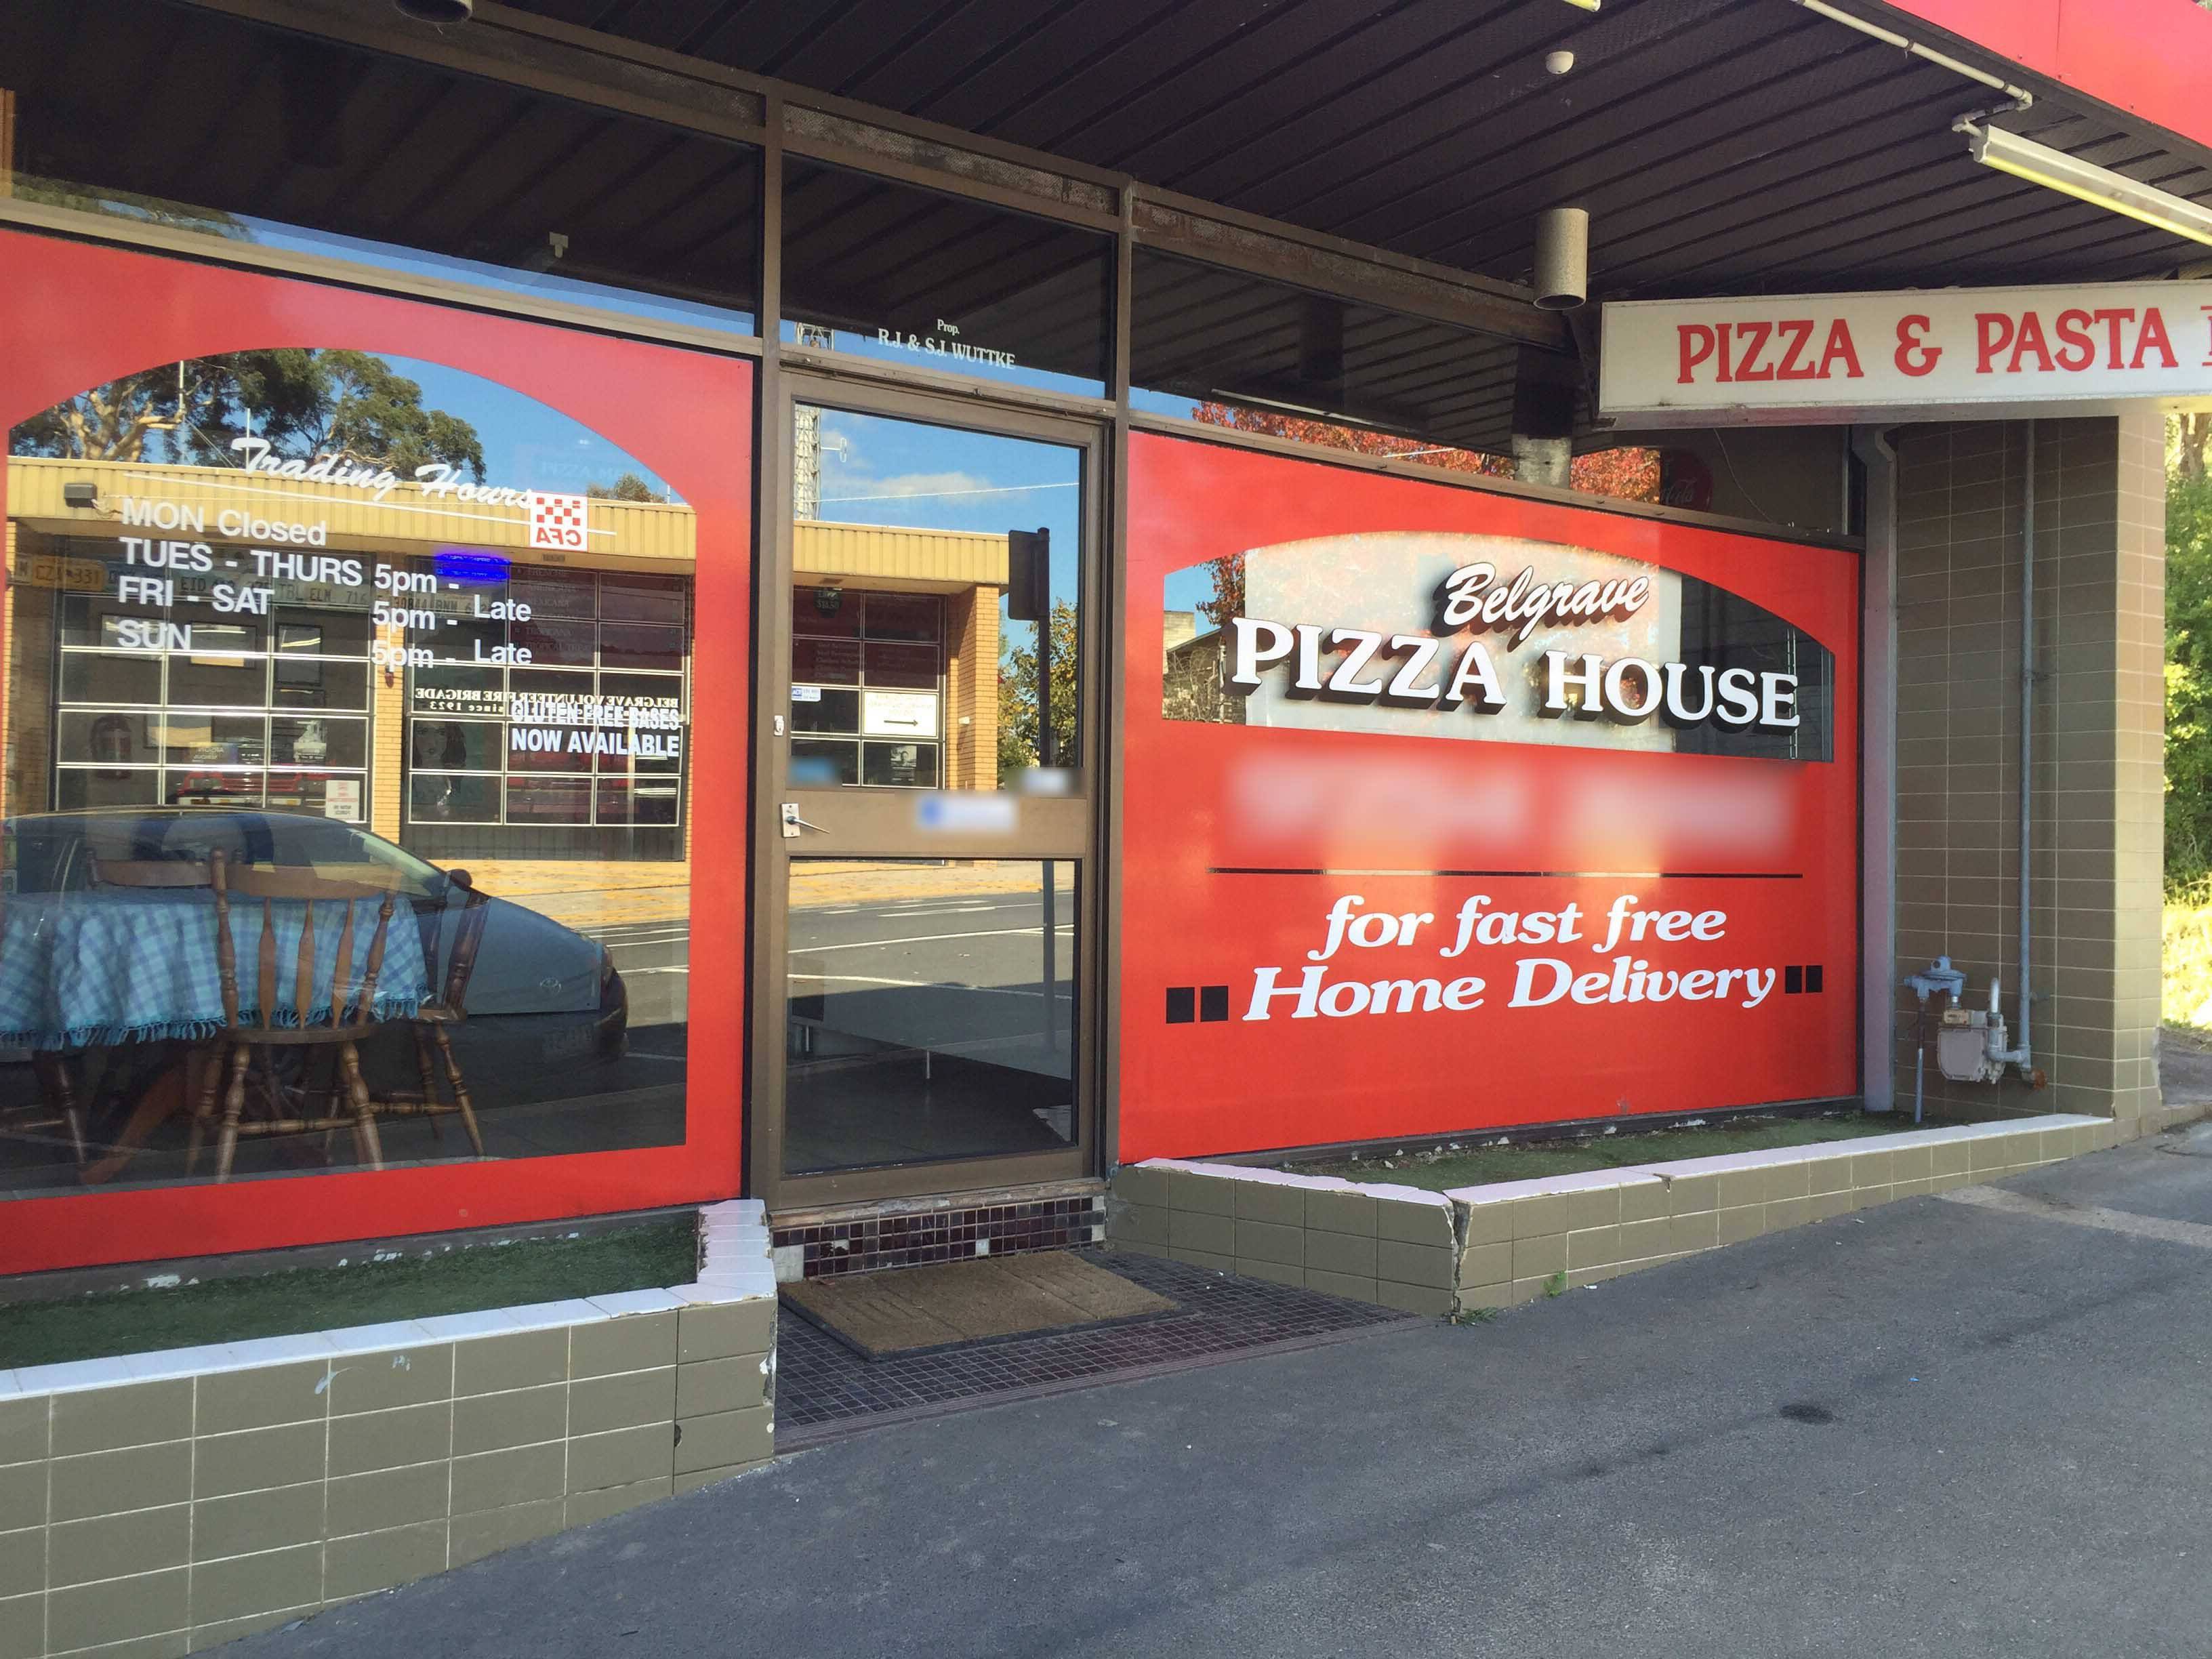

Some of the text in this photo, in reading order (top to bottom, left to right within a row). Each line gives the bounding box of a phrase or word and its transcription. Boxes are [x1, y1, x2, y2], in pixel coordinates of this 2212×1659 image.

[878, 328, 1016, 369] R.J. & S.J. WUTTKE
[937, 319, 960, 335] Prop.
[1677, 319, 1864, 384] PIZZA
[1894, 314, 1942, 377] &
[1974, 307, 2178, 373] PASTA
[230, 437, 532, 510] Trading Hours
[121, 498, 326, 546] MON Closed
[119, 537, 213, 572] TUES
[250, 550, 363, 586] THURS
[373, 564, 437, 596] 5pm
[118, 576, 173, 607] FRI
[212, 584, 274, 615] SAT
[372, 600, 436, 630] 5pm
[474, 594, 532, 621] Late
[1441, 561, 1650, 642] Belgrave
[117, 619, 191, 650] SUN
[371, 640, 434, 672] 5pm
[474, 639, 532, 665] Late
[1229, 617, 1801, 729] PIZZA HOUSE
[511, 700, 578, 724] GLUTEN
[583, 704, 624, 727] FREE
[629, 707, 679, 730] BASES
[512, 728, 680, 756] NOW AVAILABLE
[1307, 894, 1727, 961] for fast free
[1242, 955, 1777, 1021] Home Delivery
